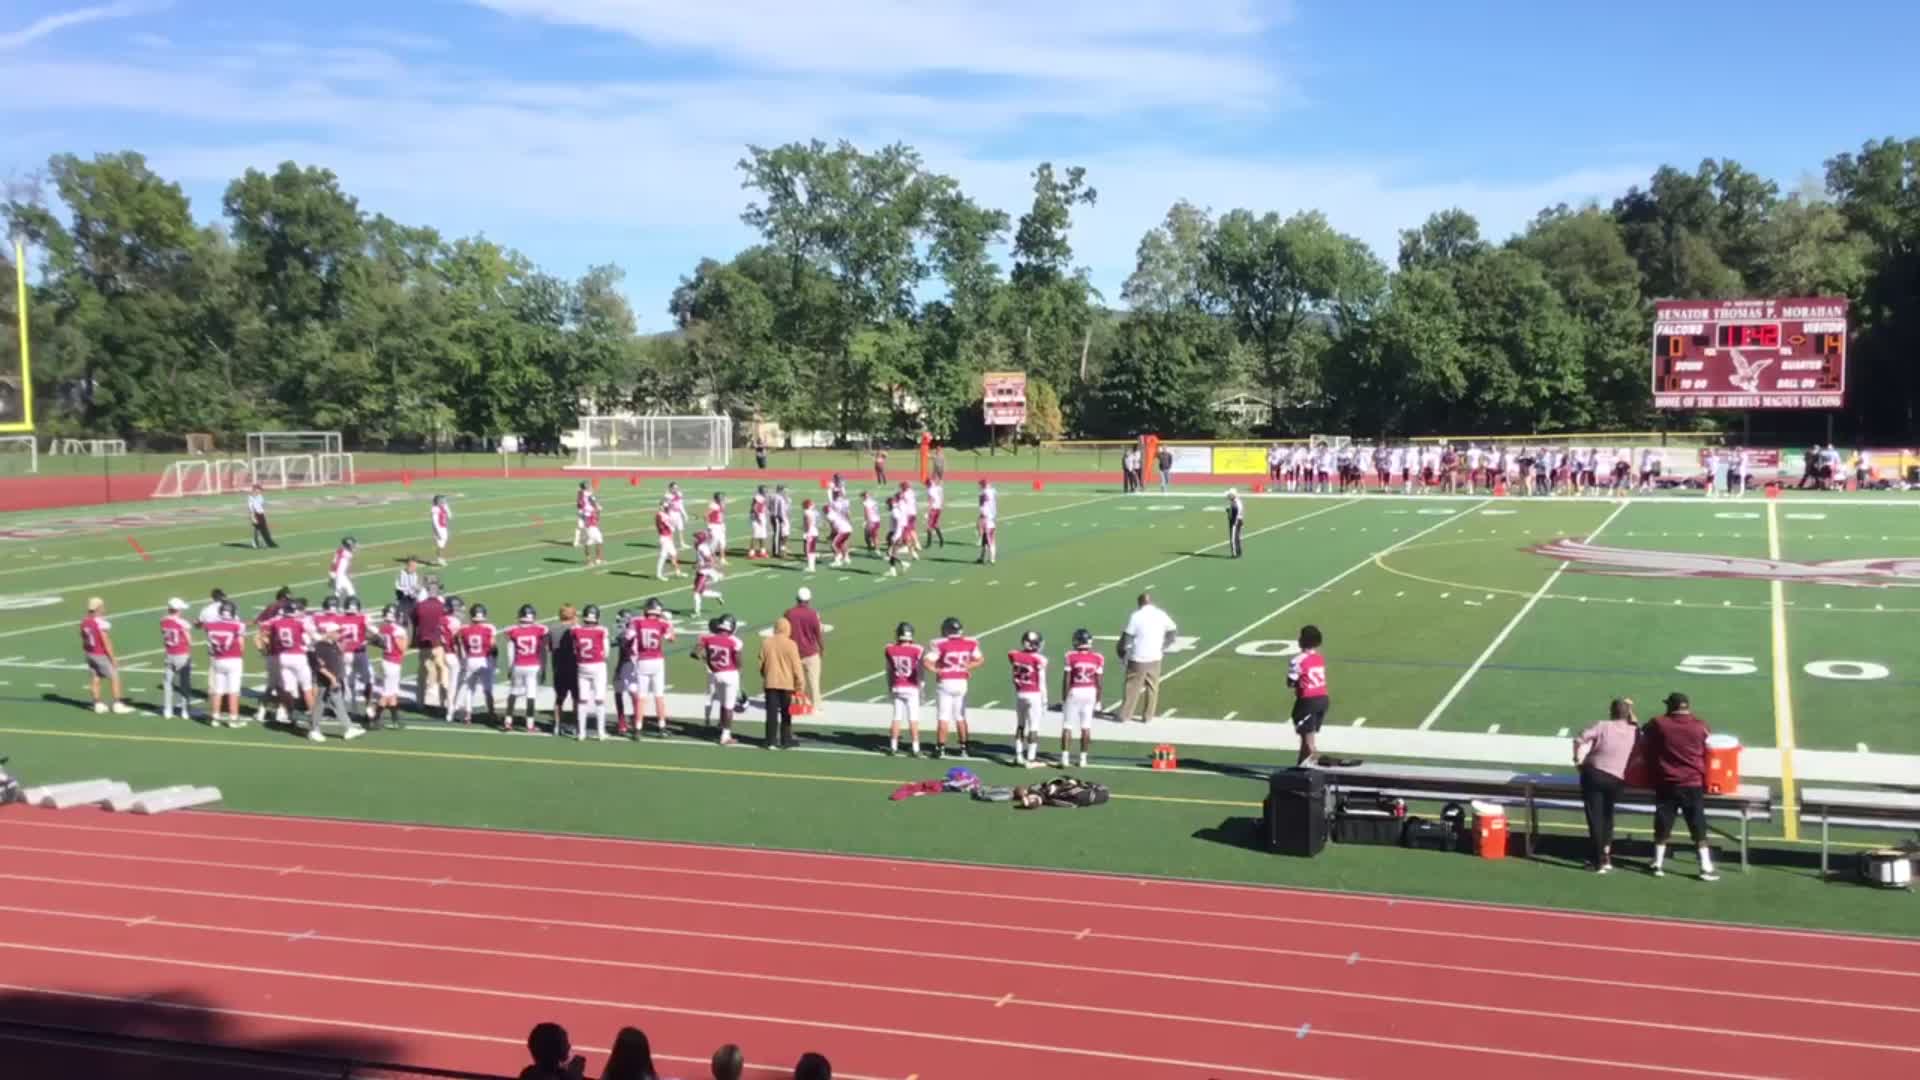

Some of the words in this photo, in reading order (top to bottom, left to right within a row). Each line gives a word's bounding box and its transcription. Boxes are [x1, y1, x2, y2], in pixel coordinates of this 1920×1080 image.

[1657, 308, 1709, 320] SENATOR
[1713, 307, 1762, 319] THOMAS
[1782, 306, 1842, 318] MORAHAN
[1655, 324, 1704, 336] FALCONS
[1655, 396, 1681, 408] HOME
[1697, 396, 1714, 408] THE
[1716, 396, 1761, 408] ALBERTUS
[1762, 396, 1799, 408] MAGNUS
[1801, 396, 1841, 408] FALCONS
[468, 634, 483, 653] 9
[516, 634, 538, 656] 51
[580, 637, 594, 659] 2
[641, 628, 660, 650] 16
